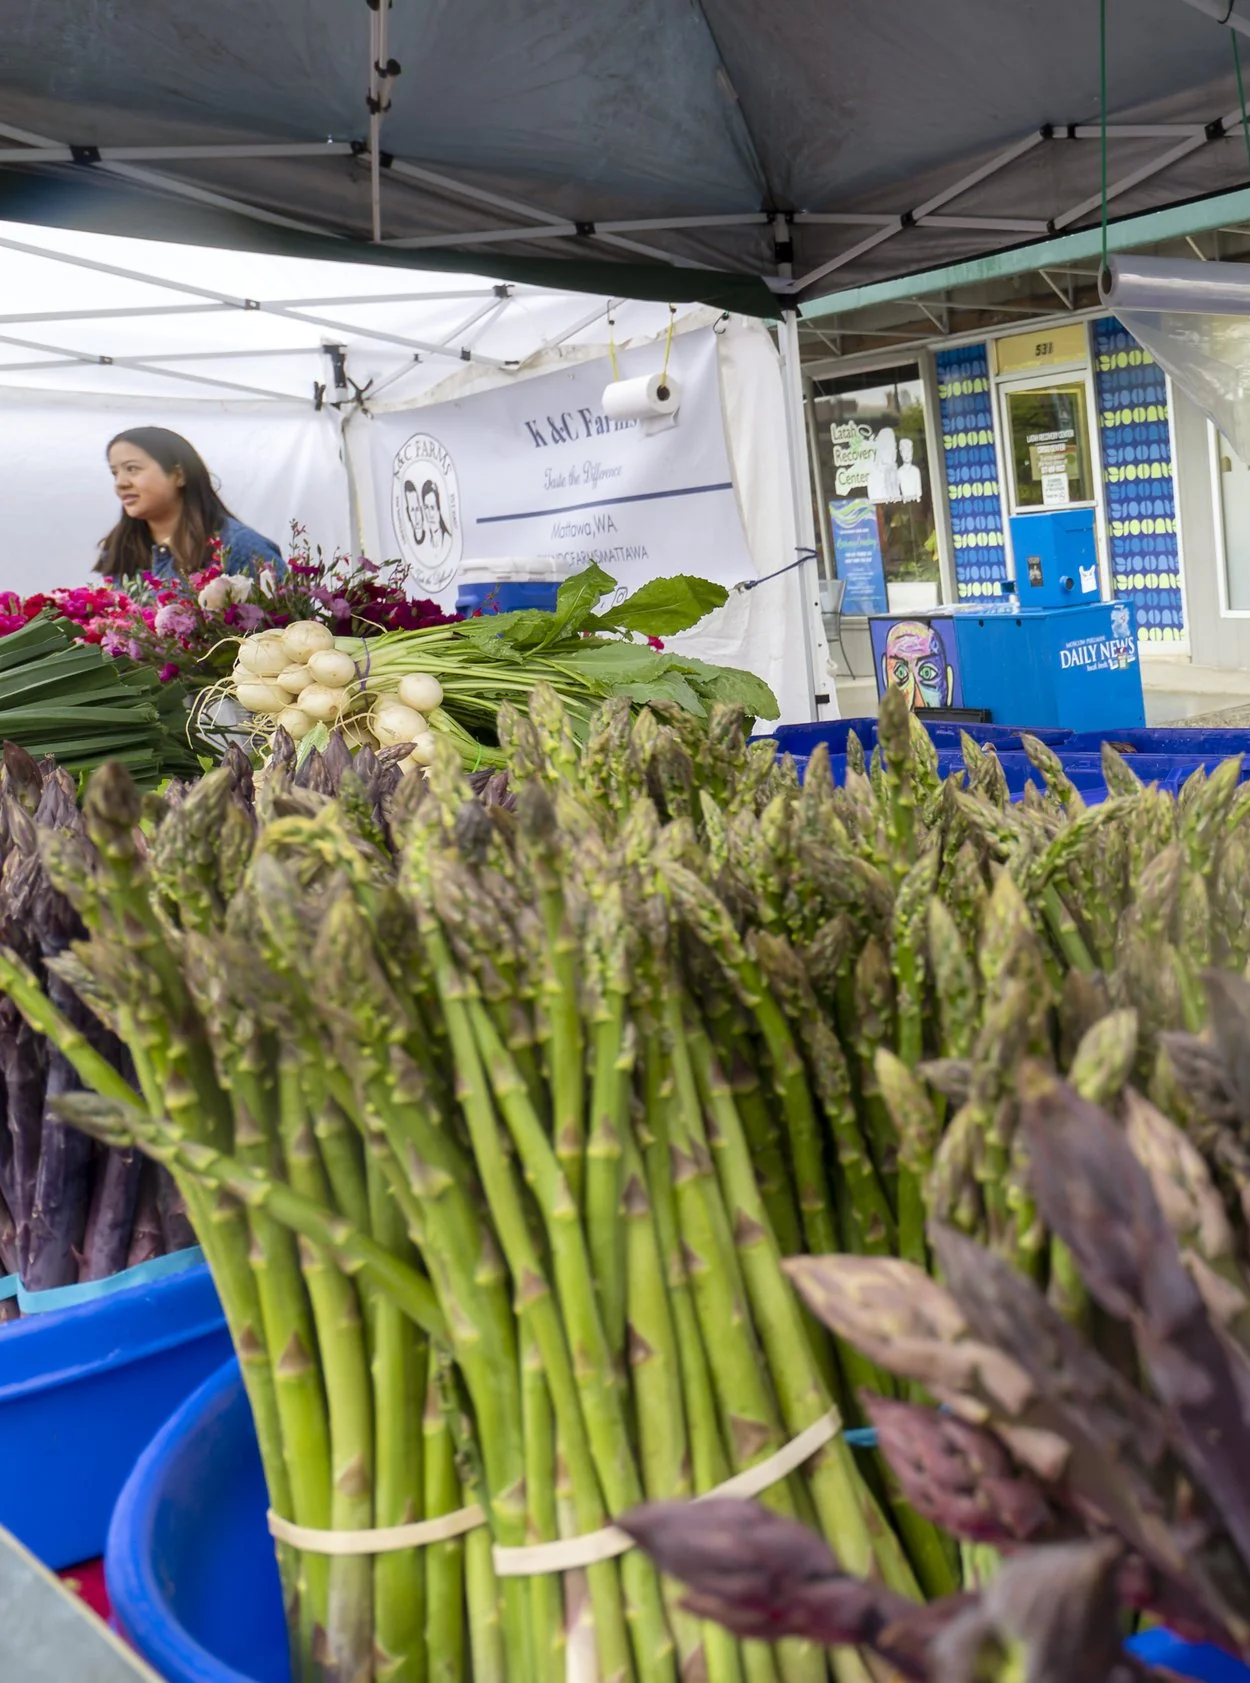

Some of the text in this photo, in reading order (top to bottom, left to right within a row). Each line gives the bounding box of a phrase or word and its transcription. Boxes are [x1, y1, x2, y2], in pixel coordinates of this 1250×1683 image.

[1035, 342, 1054, 357] 531
[415, 440, 451, 476] FARMS
[837, 447, 877, 463] Recovery
[544, 460, 623, 490] Taste the Difference
[839, 471, 870, 485] Center
[1060, 644, 1098, 669] DAILY
[1100, 636, 1135, 660] NEWS
